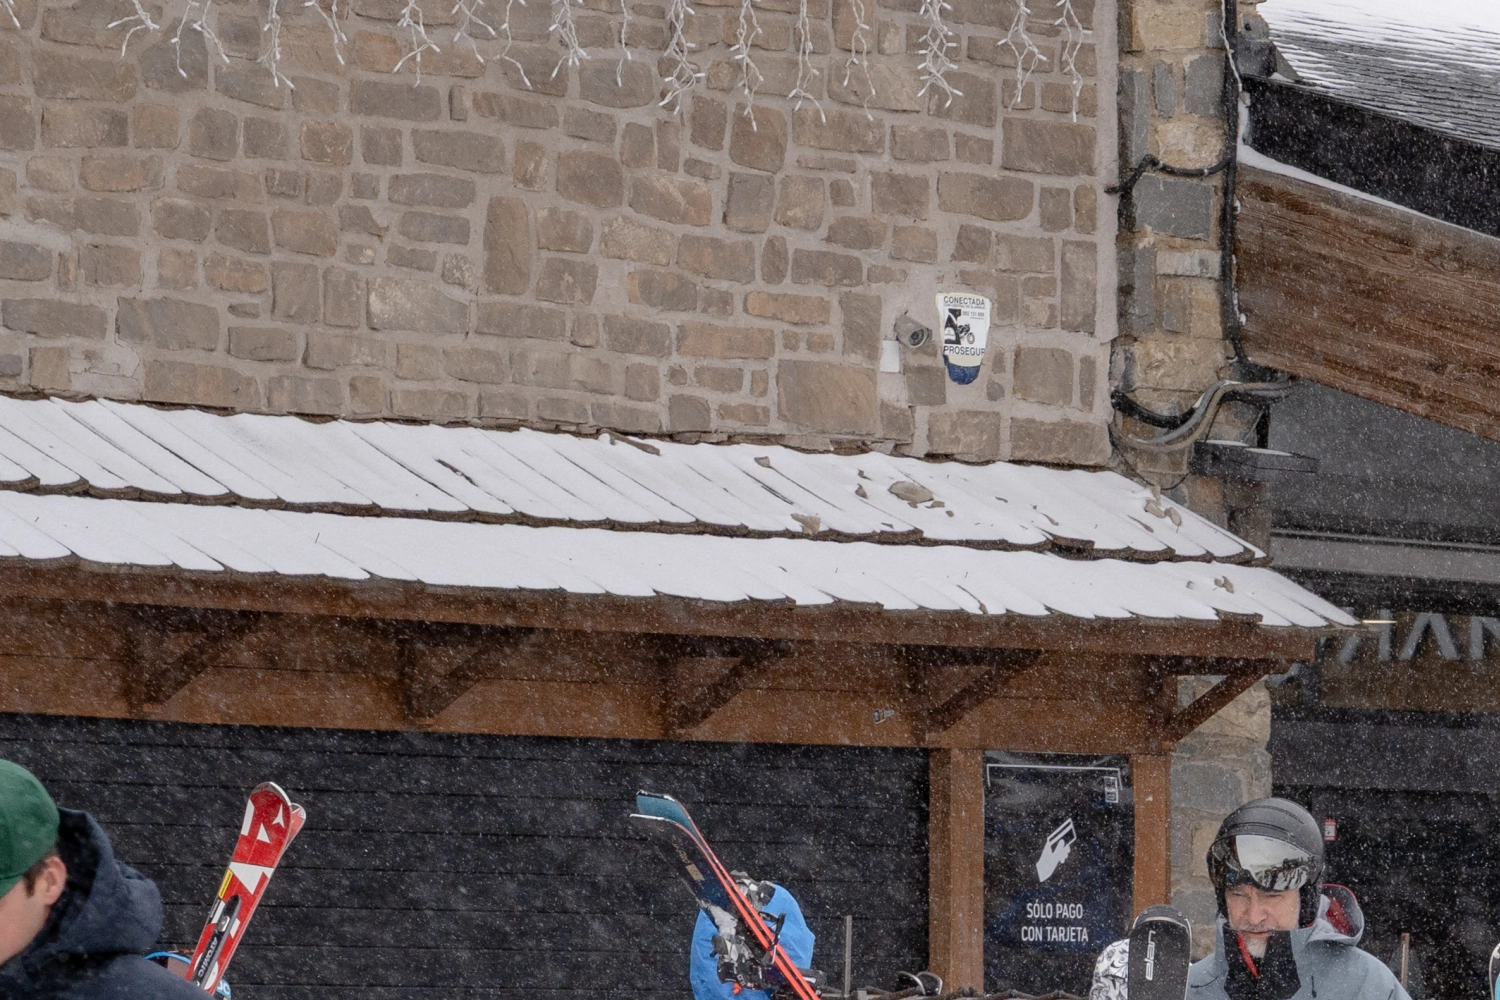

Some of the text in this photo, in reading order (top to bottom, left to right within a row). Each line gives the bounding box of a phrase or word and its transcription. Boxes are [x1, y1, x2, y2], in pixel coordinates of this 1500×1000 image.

[943, 295, 985, 306] CONECTADA
[1026, 899, 1084, 919] SÓLO PAGO
[1021, 926, 1089, 942] CON TARJETA
[198, 935, 219, 978] ATOMIC
[1143, 929, 1157, 981] elan
